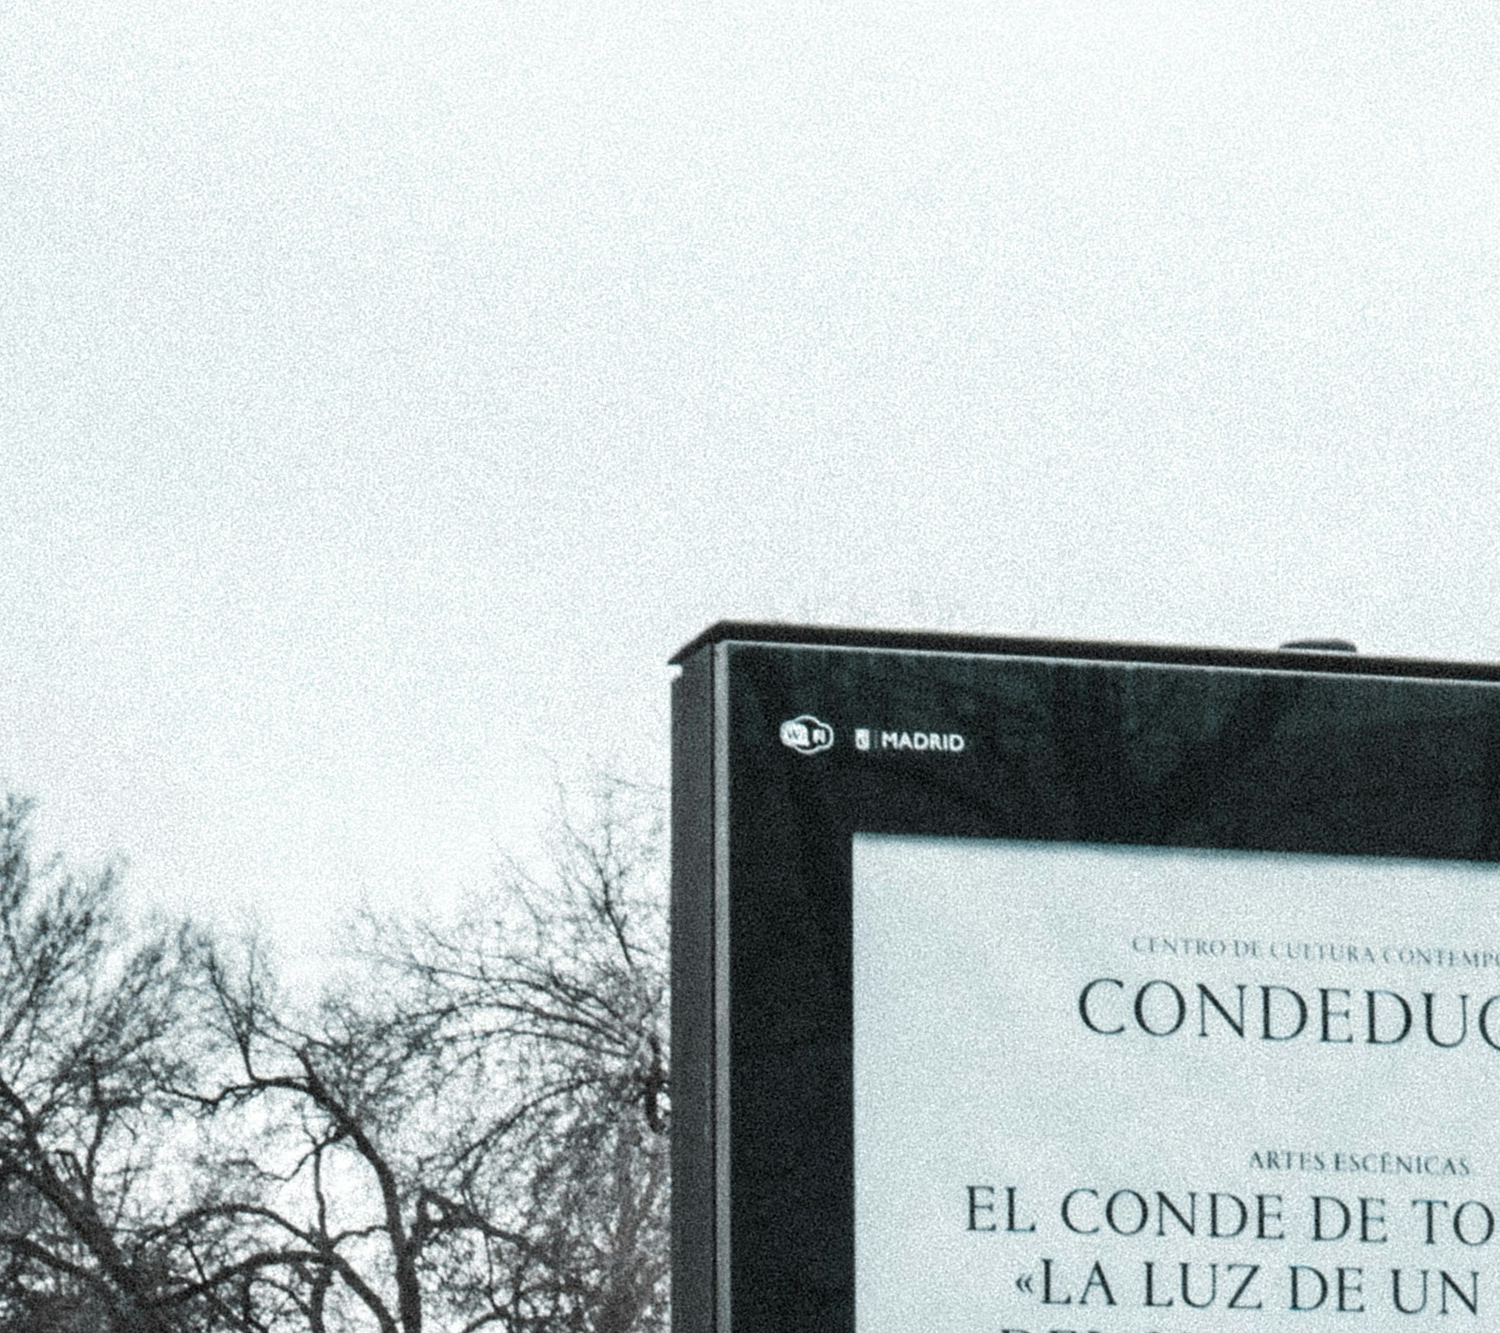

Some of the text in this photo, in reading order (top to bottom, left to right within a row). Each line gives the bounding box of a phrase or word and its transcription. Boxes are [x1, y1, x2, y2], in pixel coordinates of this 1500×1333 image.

[881, 731, 965, 752] MADRID
[1132, 937, 1226, 957] CENTRO
[1233, 939, 1264, 958] DE
[1269, 941, 1377, 964] CULTURA
[1250, 1150, 1325, 1173] ARTES
[965, 1185, 1036, 1234] EL
[1060, 1187, 1286, 1240] CONDE
[1311, 1194, 1388, 1244] DE
[1014, 1258, 1118, 1307] «LA
[1143, 1261, 1263, 1310] LUZ
[1288, 1265, 1366, 1314] DE
[1391, 1269, 1480, 1317] UN
